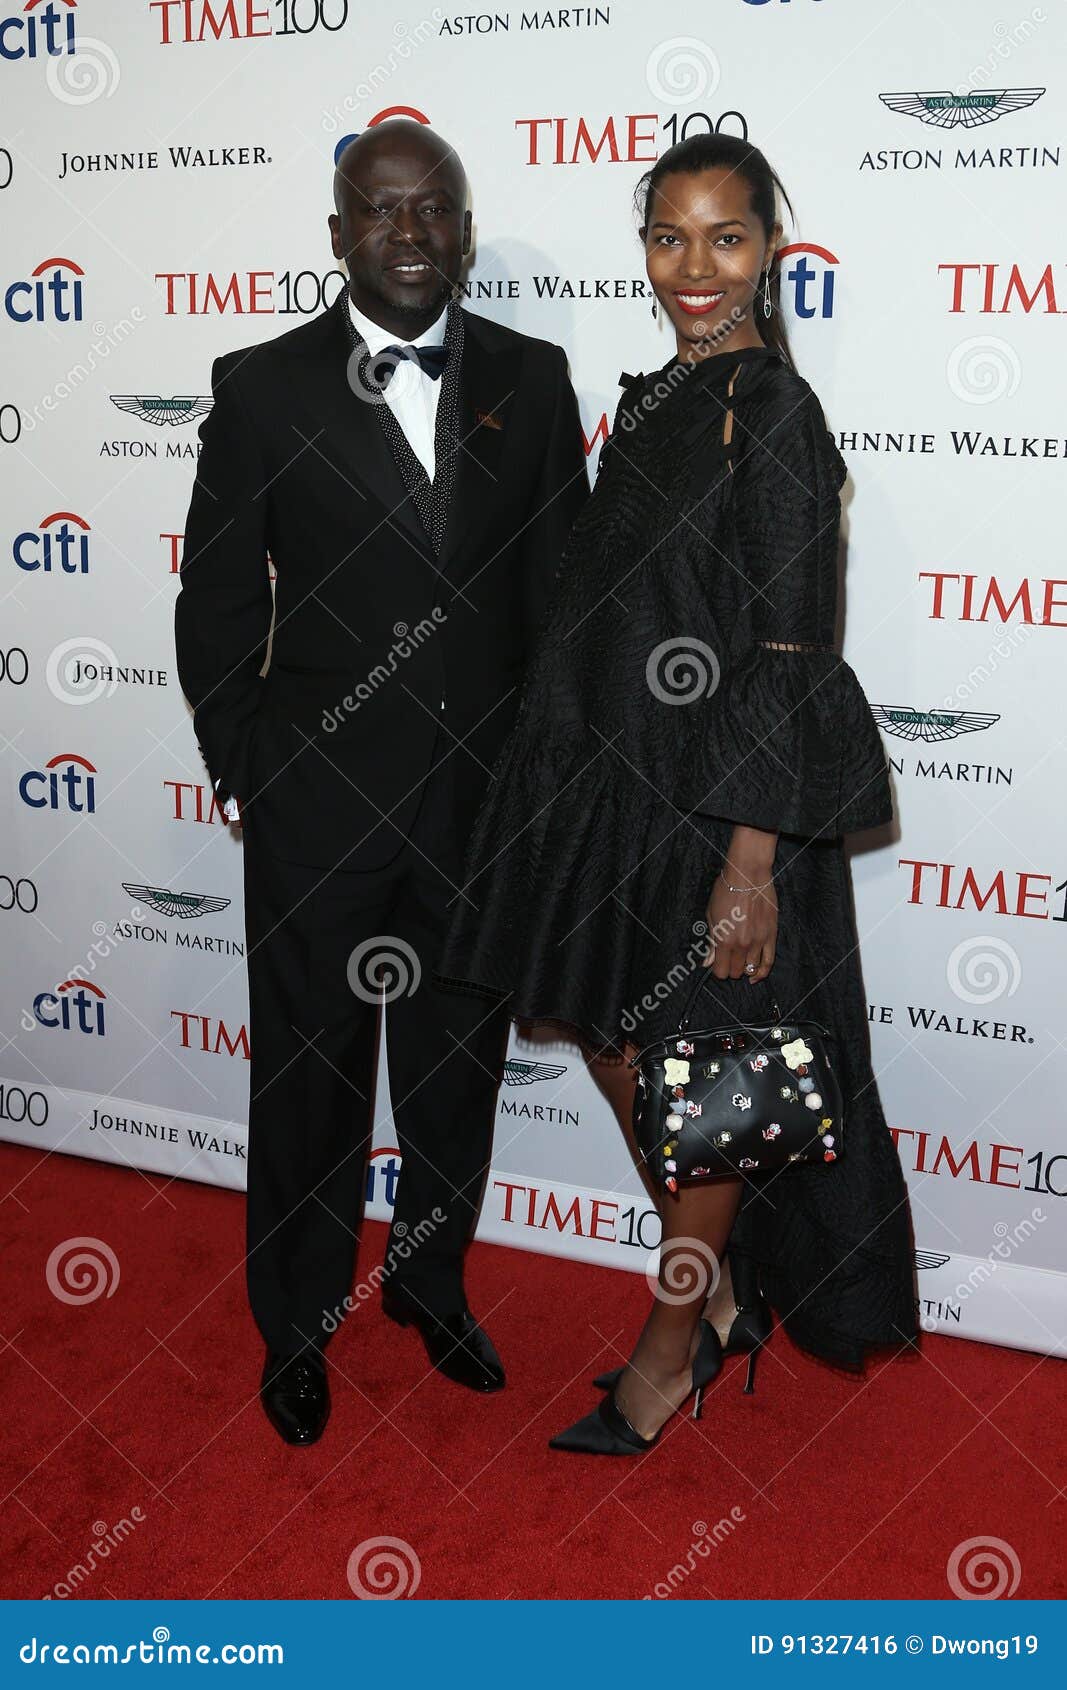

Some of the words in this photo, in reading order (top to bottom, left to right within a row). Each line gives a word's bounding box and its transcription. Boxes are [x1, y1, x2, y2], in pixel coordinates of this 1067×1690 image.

[0, 2, 76, 60] citi
[439, 14, 509, 36] ASTON
[520, 7, 611, 31] MARTIN
[59, 152, 159, 179] JOHNNIE
[859, 150, 942, 170] ASTON
[954, 147, 1060, 169] MARTIN
[4, 269, 84, 323] citi
[937, 263, 1067, 315] TIM
[99, 441, 157, 457] ASTON
[950, 431, 1067, 458] WALKE
[12, 523, 89, 573] citi
[73, 660, 168, 687] JOHNNIE
[915, 760, 1013, 785] MARTIN
[19, 765, 96, 814] citi
[113, 922, 168, 944] ASTON
[175, 932, 244, 957] MARTIN
[33, 989, 106, 1037] citi
[89, 1109, 179, 1144] JOHNNIE
[500, 1099, 579, 1127] MARTIN
